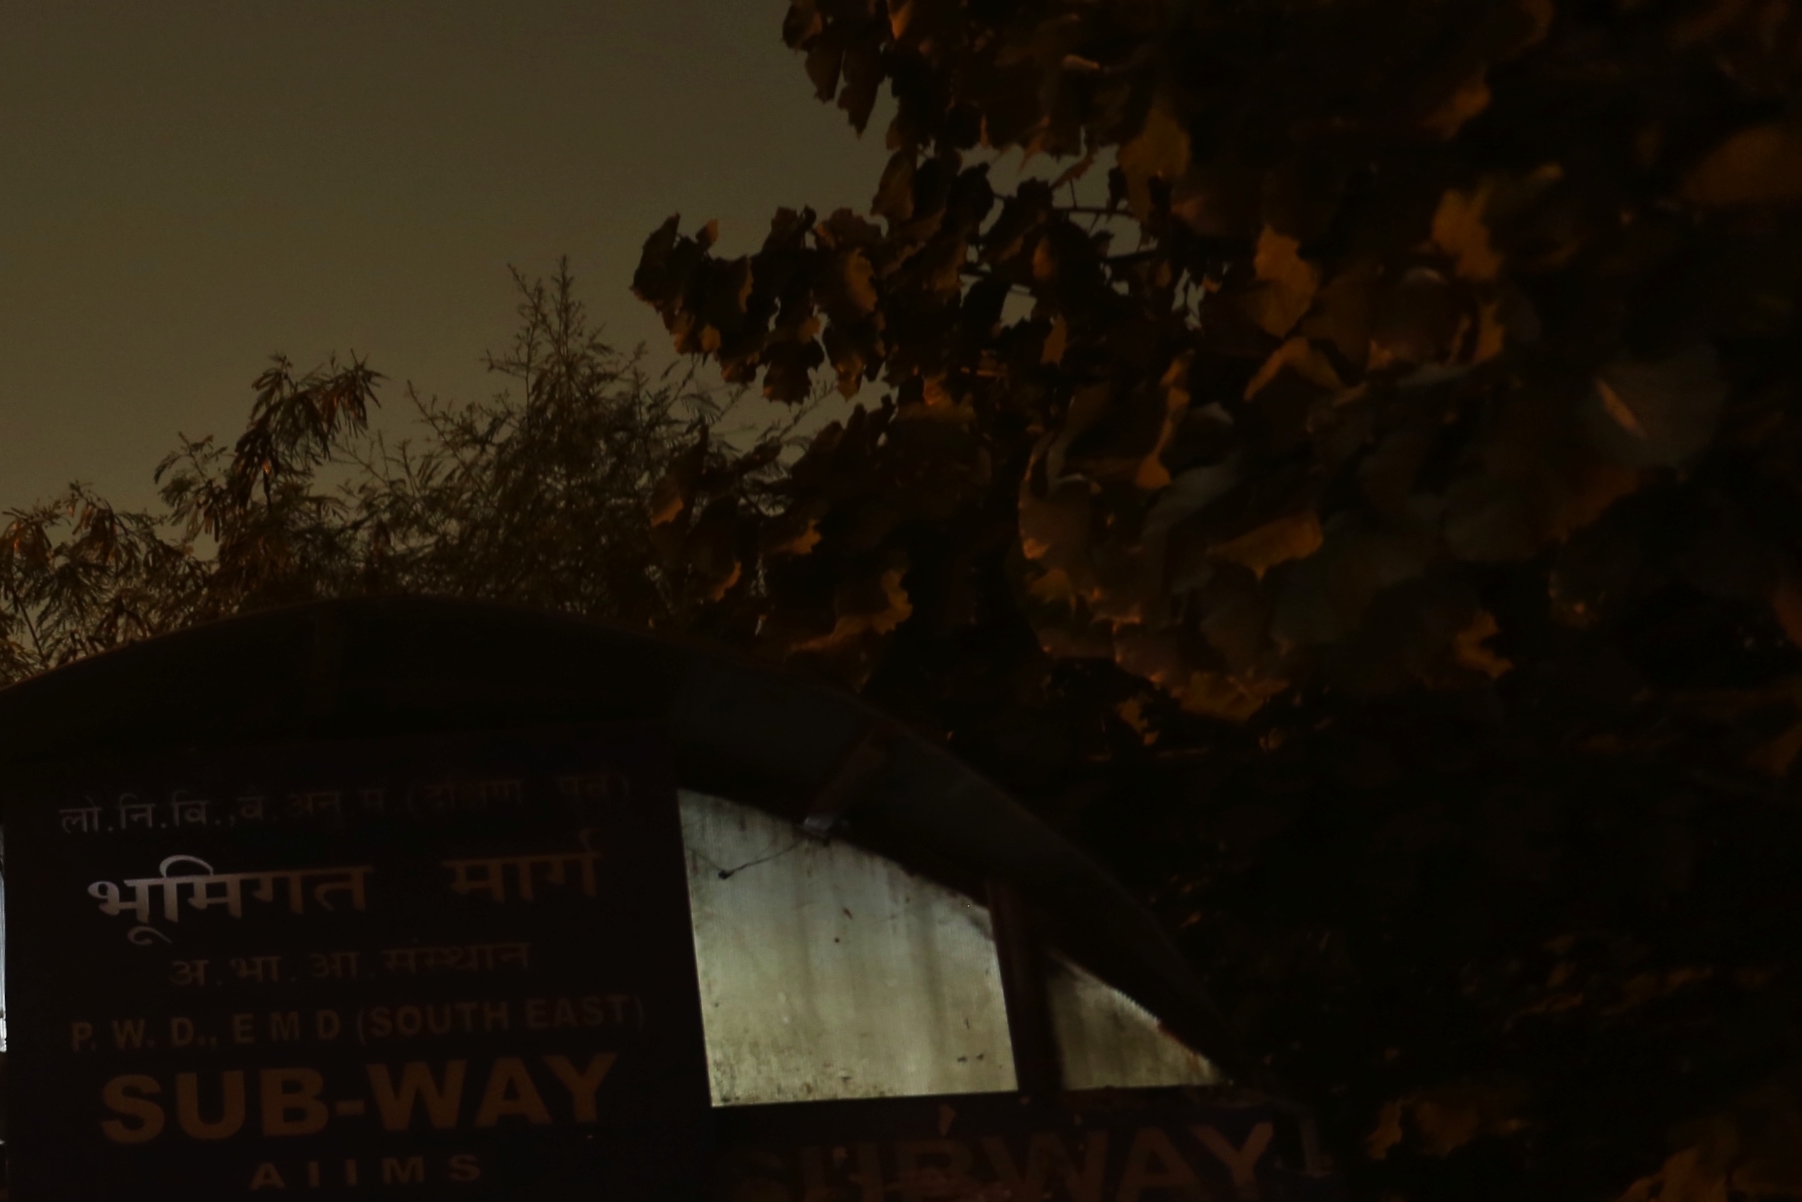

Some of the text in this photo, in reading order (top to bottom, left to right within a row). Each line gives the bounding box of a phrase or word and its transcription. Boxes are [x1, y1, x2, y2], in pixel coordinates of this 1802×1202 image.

[86, 828, 603, 946] भूमिगत मार्ग
[354, 998, 510, 1045] (SOUTH
[100, 1051, 619, 1145] SUB-WAY
